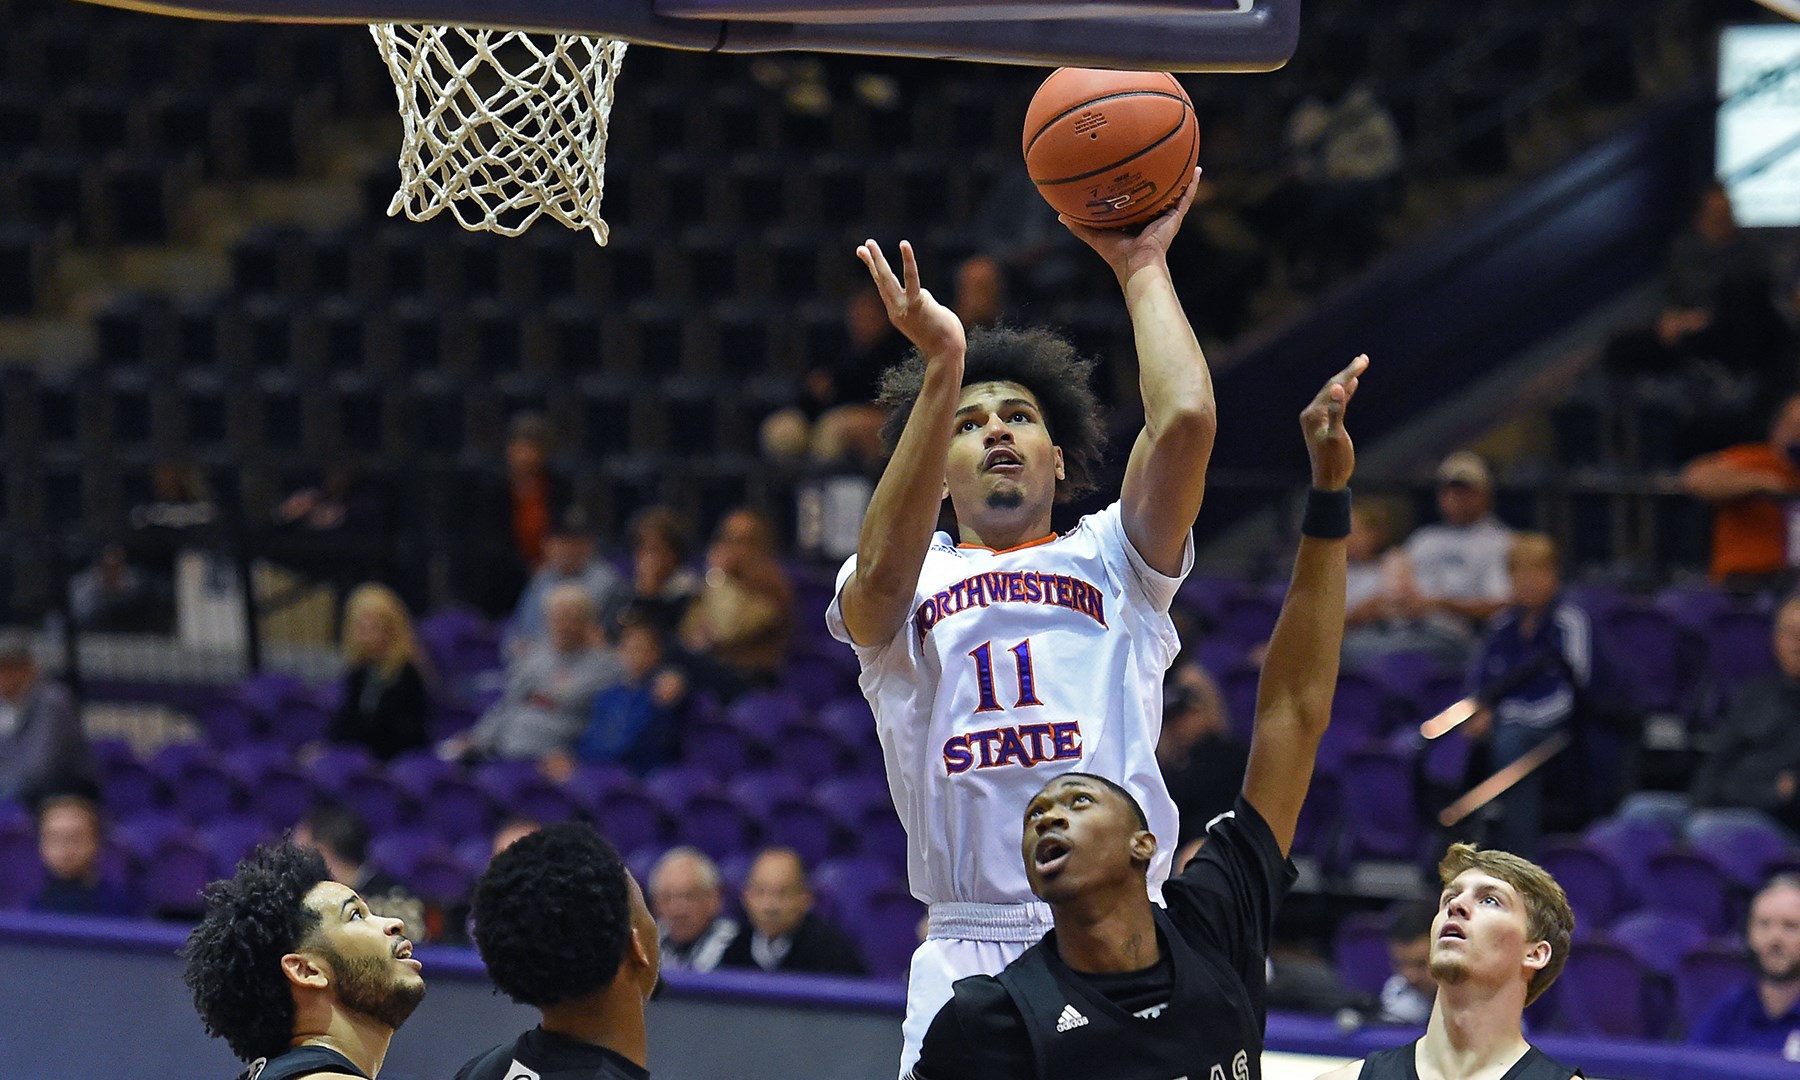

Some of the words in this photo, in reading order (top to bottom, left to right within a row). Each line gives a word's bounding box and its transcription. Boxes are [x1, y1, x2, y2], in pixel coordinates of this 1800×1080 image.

[968, 638, 1044, 713] 11
[943, 721, 1082, 776] STATE
[1056, 1015, 1089, 1032] adidas
